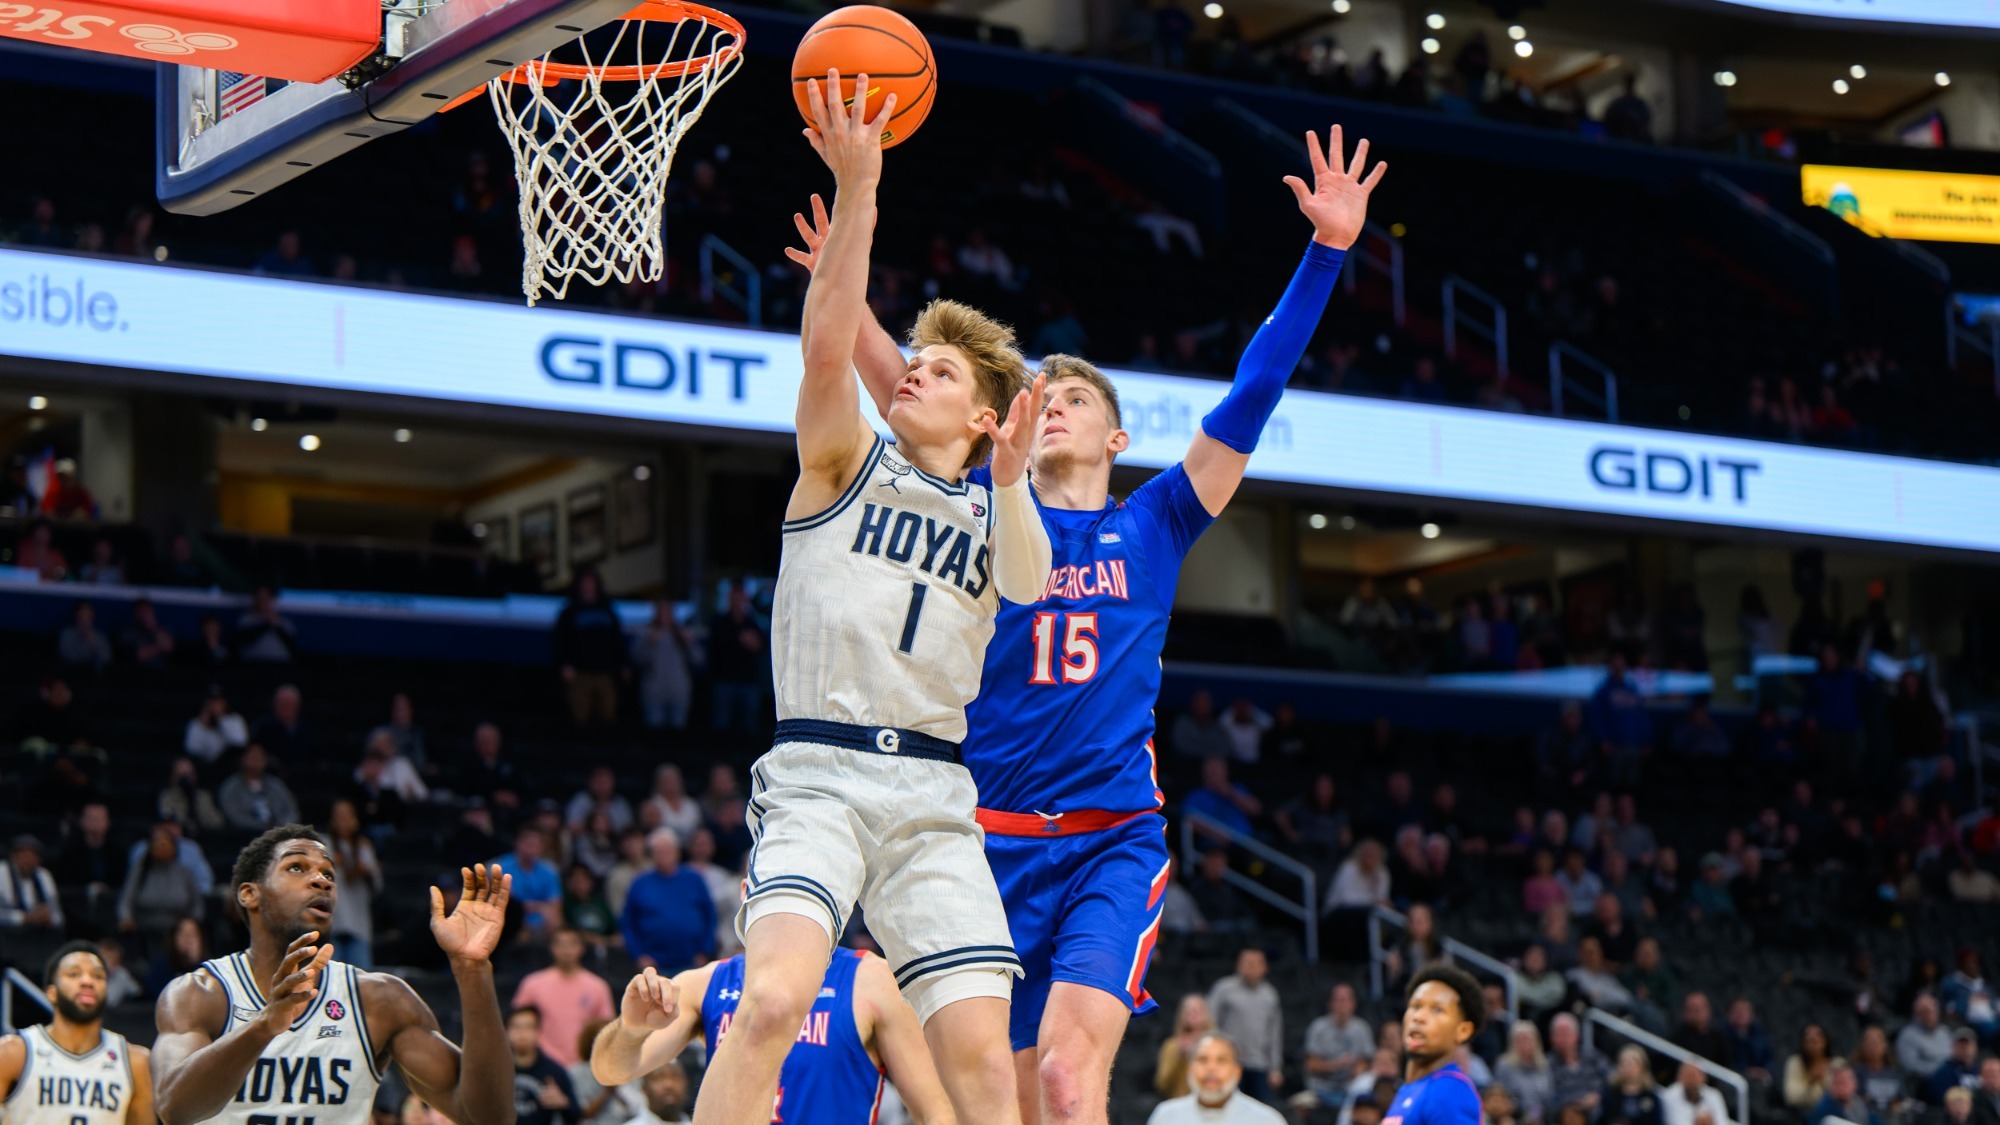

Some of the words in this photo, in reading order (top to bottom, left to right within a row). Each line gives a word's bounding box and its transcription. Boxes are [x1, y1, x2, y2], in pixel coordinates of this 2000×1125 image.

[540, 336, 766, 400] GDIT
[1590, 448, 1760, 501] GDIT
[850, 502, 990, 600] HOYAS
[897, 581, 929, 655] 1
[1027, 611, 1100, 686] 15
[875, 728, 901, 754] G
[38, 1076, 122, 1113] HOYAS
[234, 1057, 352, 1105] OYAS
